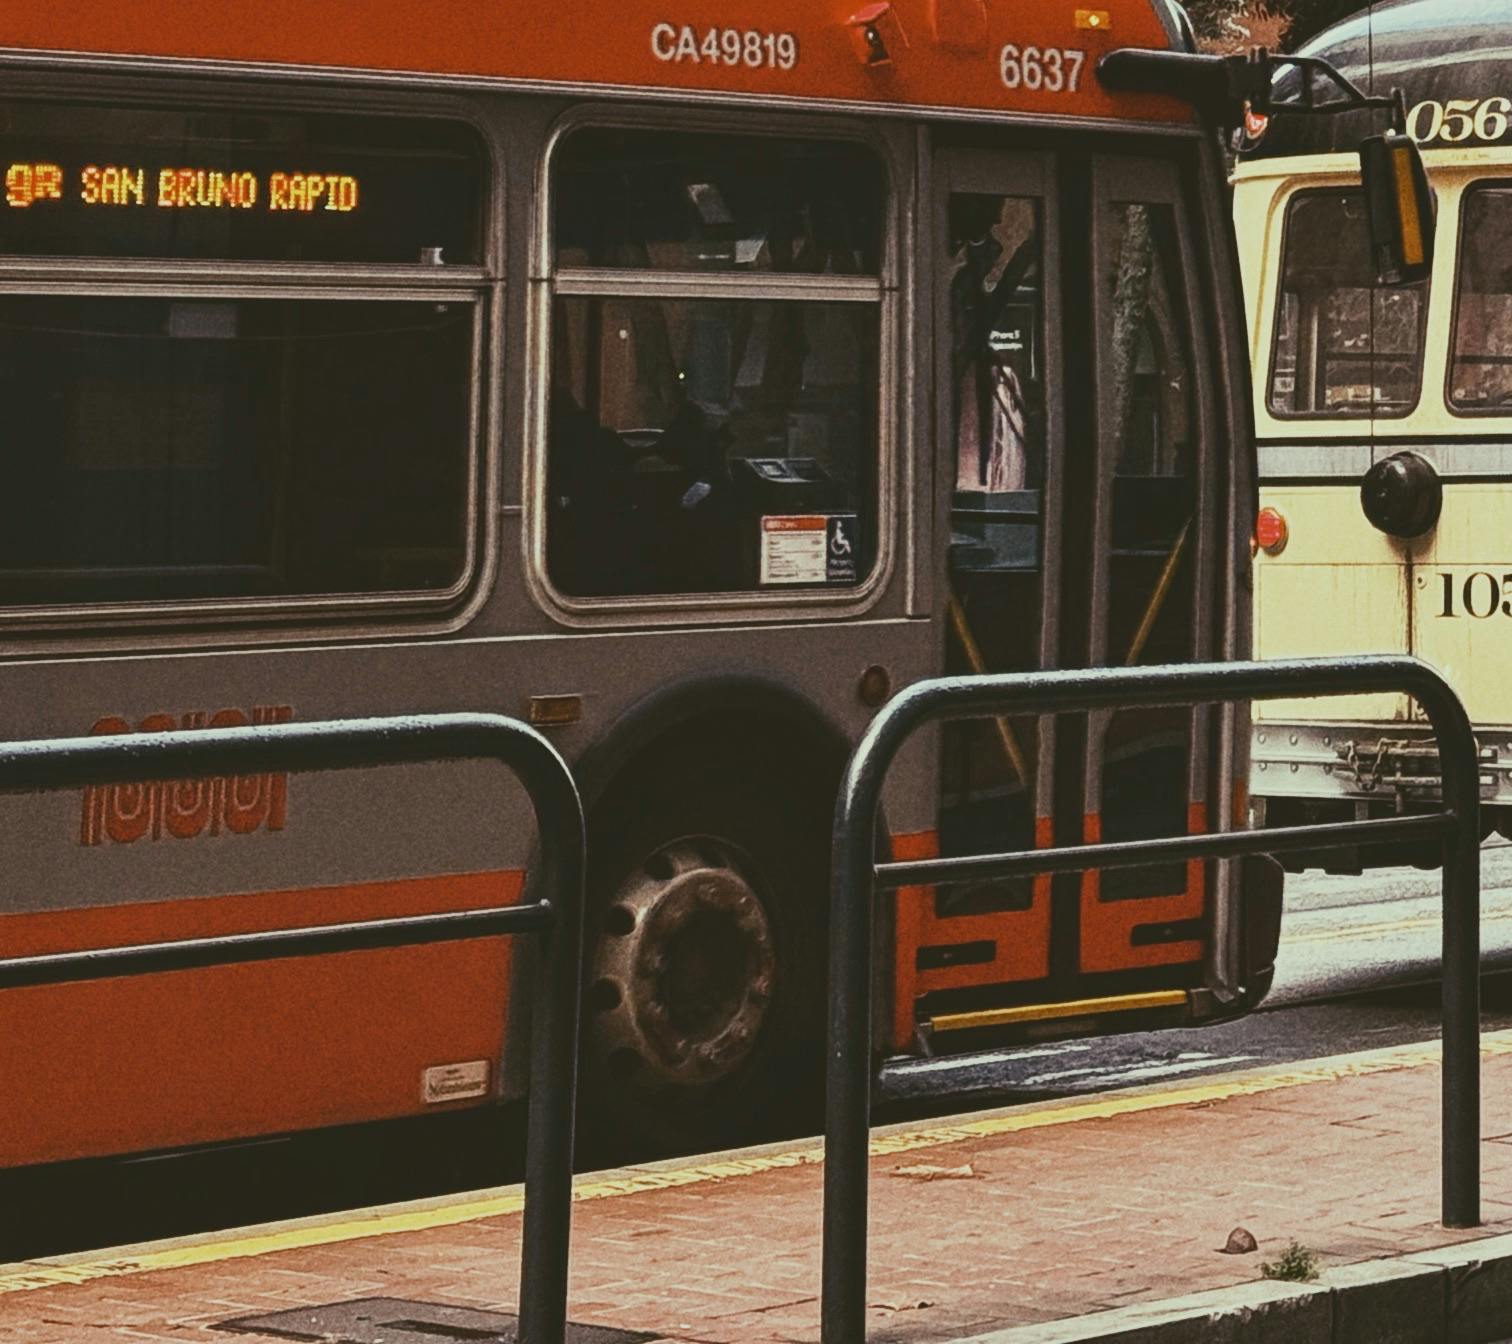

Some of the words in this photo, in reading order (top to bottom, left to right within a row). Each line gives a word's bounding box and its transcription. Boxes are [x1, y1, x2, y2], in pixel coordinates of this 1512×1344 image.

[651, 22, 797, 70] CA49819
[1000, 43, 1085, 93] 6637
[1405, 96, 1512, 143] 056
[81, 166, 144, 206] SAN
[157, 169, 257, 209] BRUNO
[269, 172, 358, 212] RAPID
